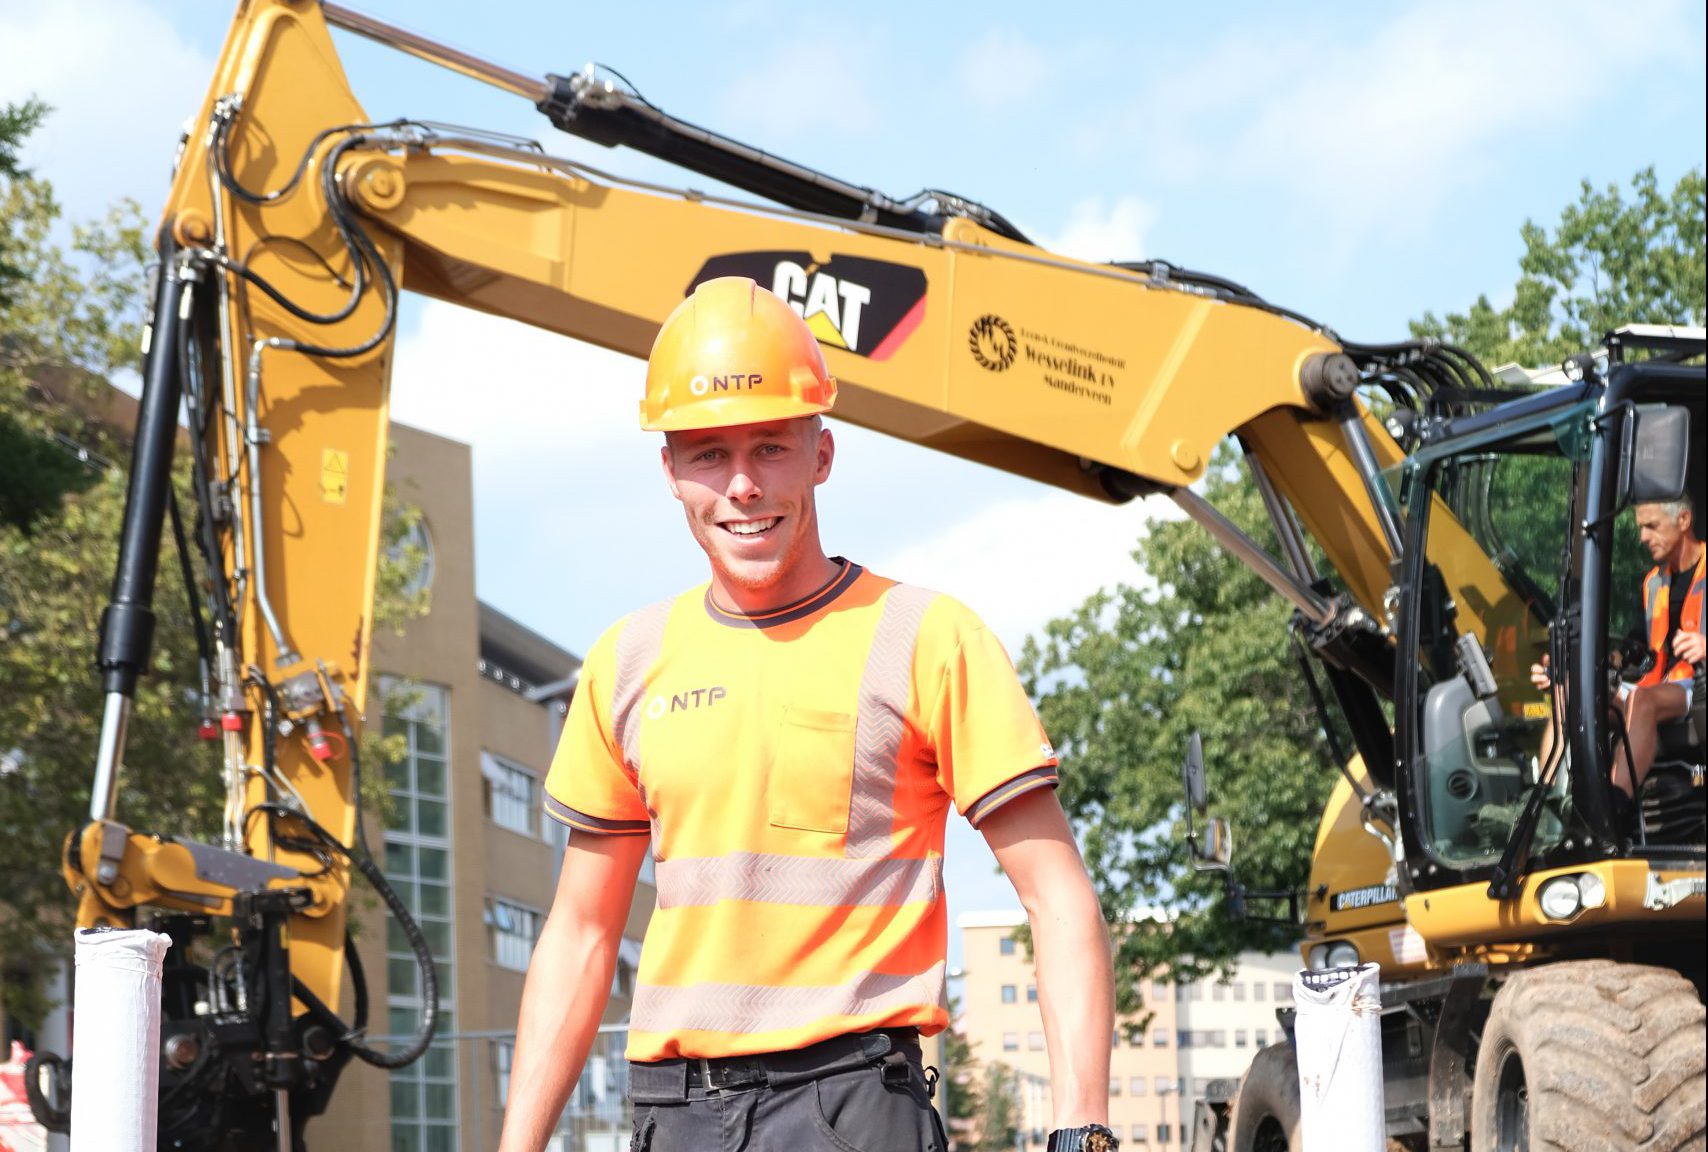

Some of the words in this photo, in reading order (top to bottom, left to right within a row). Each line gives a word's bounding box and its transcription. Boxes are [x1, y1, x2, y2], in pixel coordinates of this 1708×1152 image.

[773, 260, 871, 352] CAT
[1025, 343, 1097, 383] Wesselink
[713, 374, 763, 391] NTP
[671, 686, 727, 712] NTP
